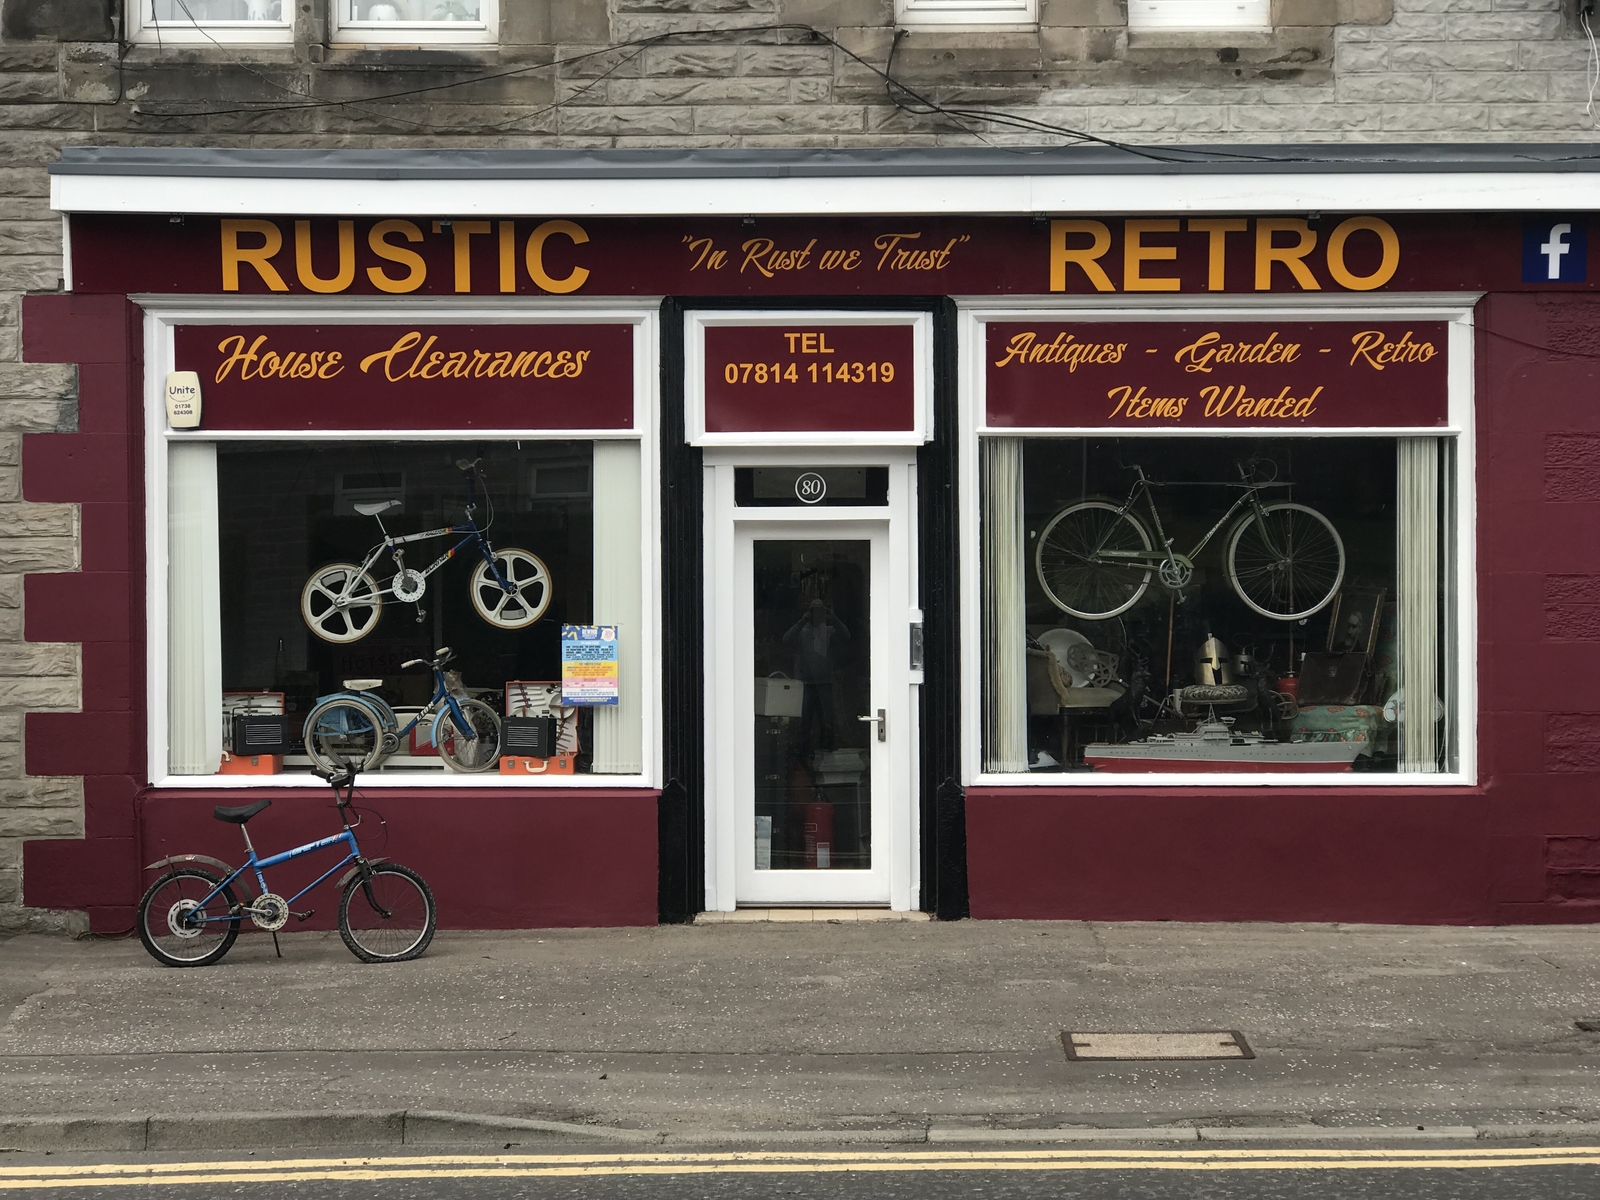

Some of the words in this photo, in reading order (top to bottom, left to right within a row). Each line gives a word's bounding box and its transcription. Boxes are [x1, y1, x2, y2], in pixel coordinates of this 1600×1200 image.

[220, 219, 591, 294] RUSTIC
[739, 238, 818, 279] Rust
[818, 248, 862, 271] we
[1049, 216, 1401, 292] RETRO
[215, 334, 345, 384] House
[359, 331, 592, 383] Clearances
[783, 332, 836, 354] TEL
[994, 331, 1128, 373] Antiques
[1174, 331, 1302, 373] Garden
[1349, 330, 1440, 371] Retro
[724, 362, 799, 384] 07814
[806, 361, 896, 384] 114319
[169, 386, 196, 395] Unite
[1106, 385, 1190, 419] Items
[1199, 384, 1325, 419] Wanted
[800, 479, 822, 496] 80
[416, 701, 435, 721] LION
